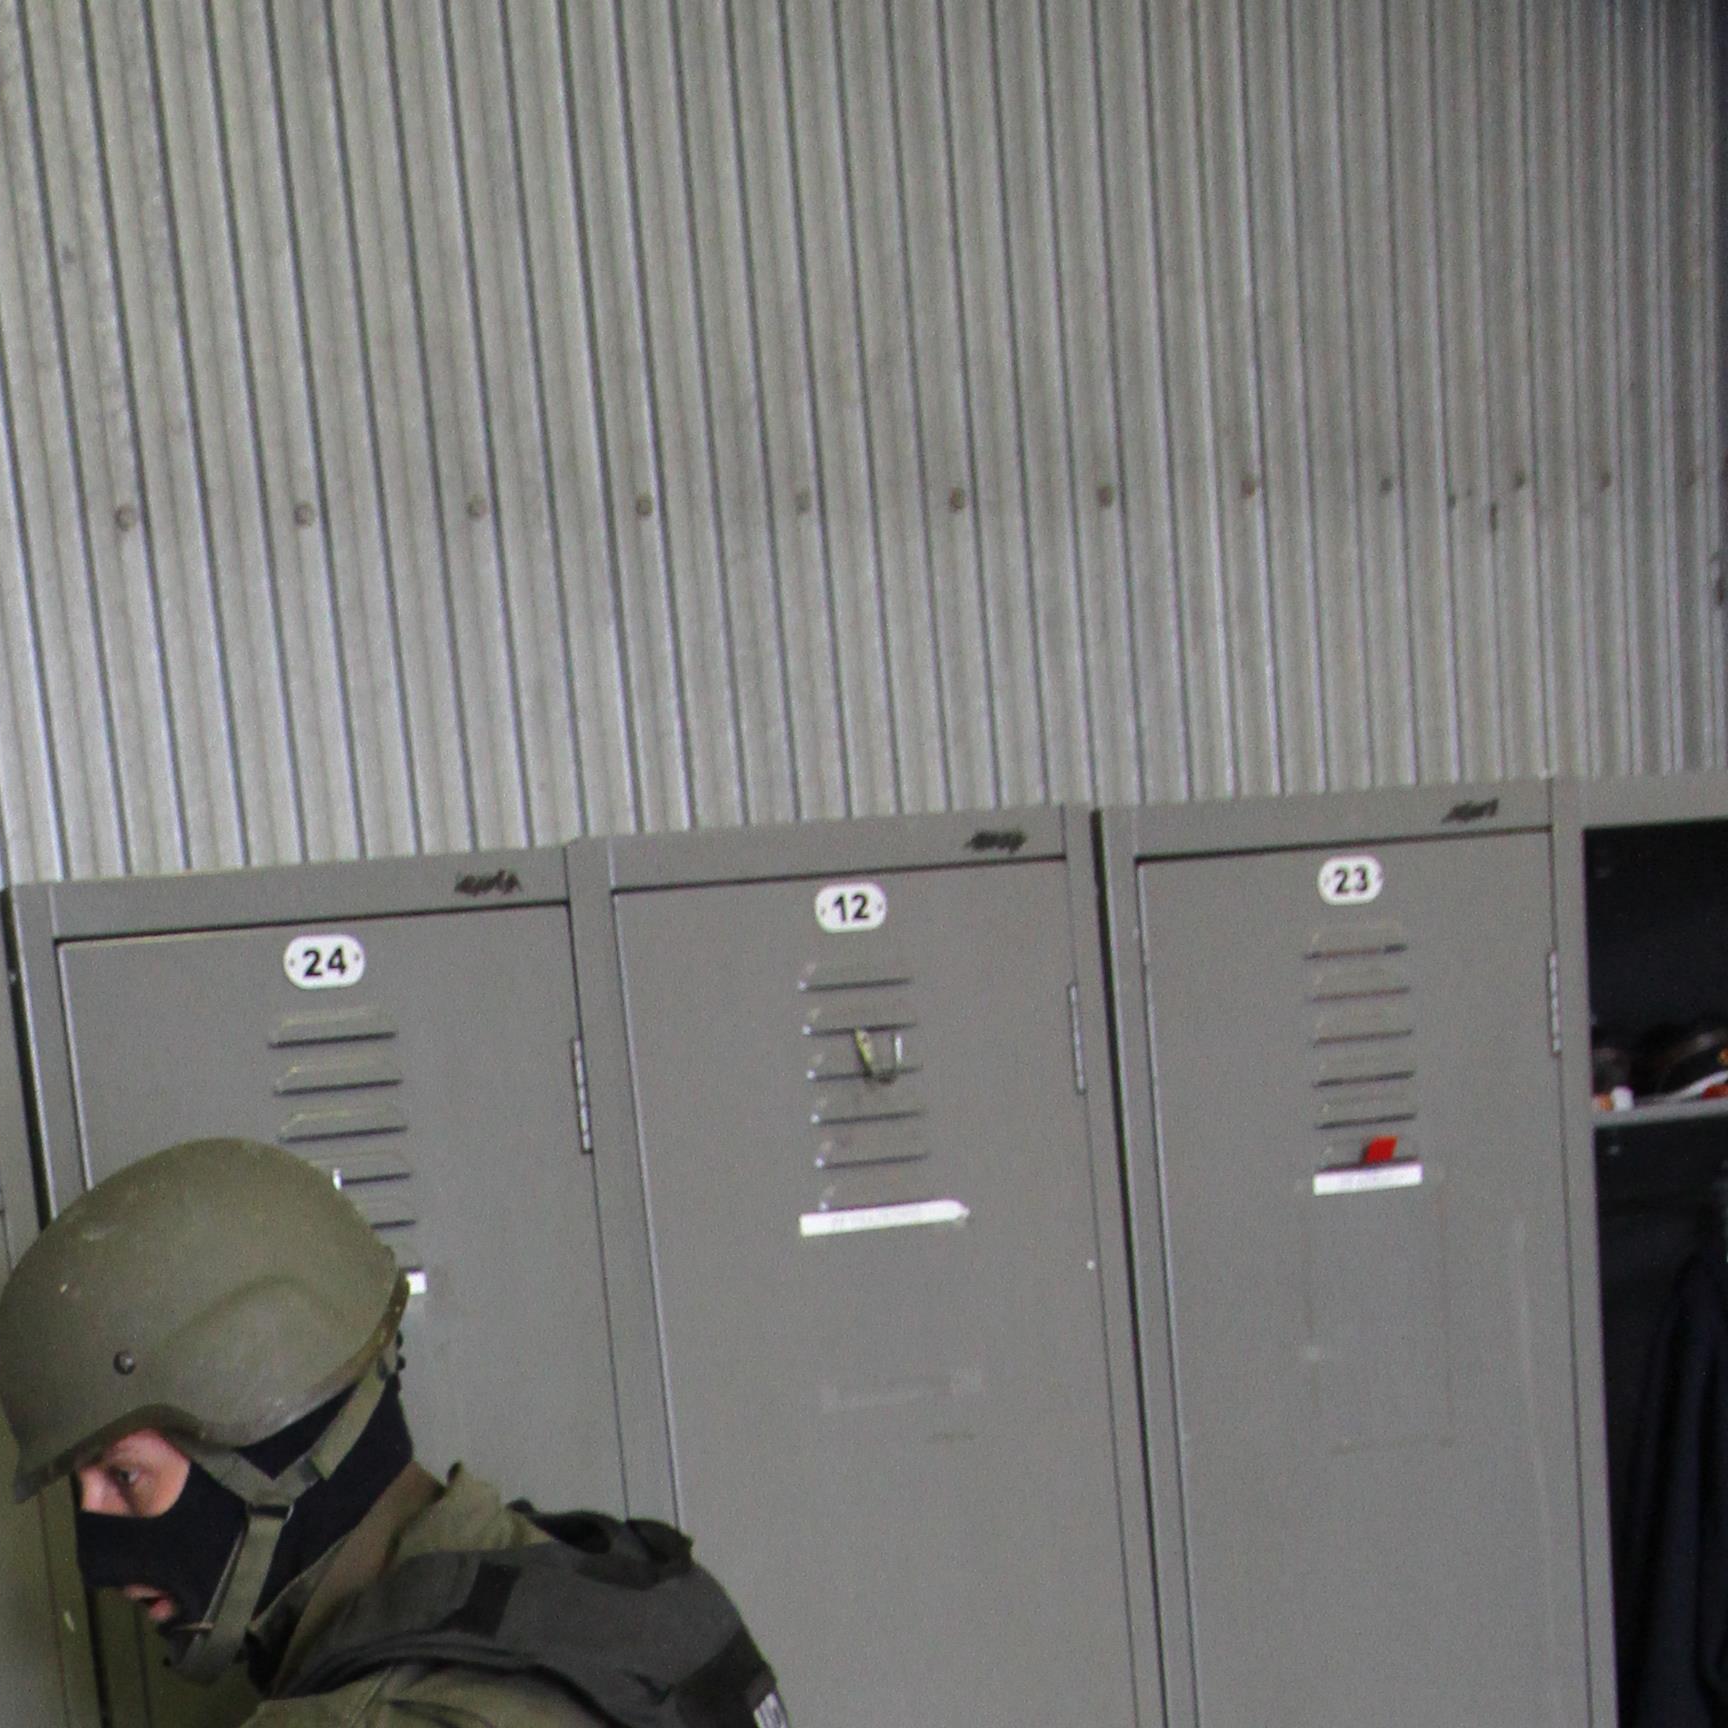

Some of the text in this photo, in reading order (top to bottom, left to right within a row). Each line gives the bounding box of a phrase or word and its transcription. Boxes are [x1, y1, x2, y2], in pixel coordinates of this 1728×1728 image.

[1334, 866, 1370, 895] 23
[833, 892, 871, 922] 12
[302, 946, 348, 978] 24
